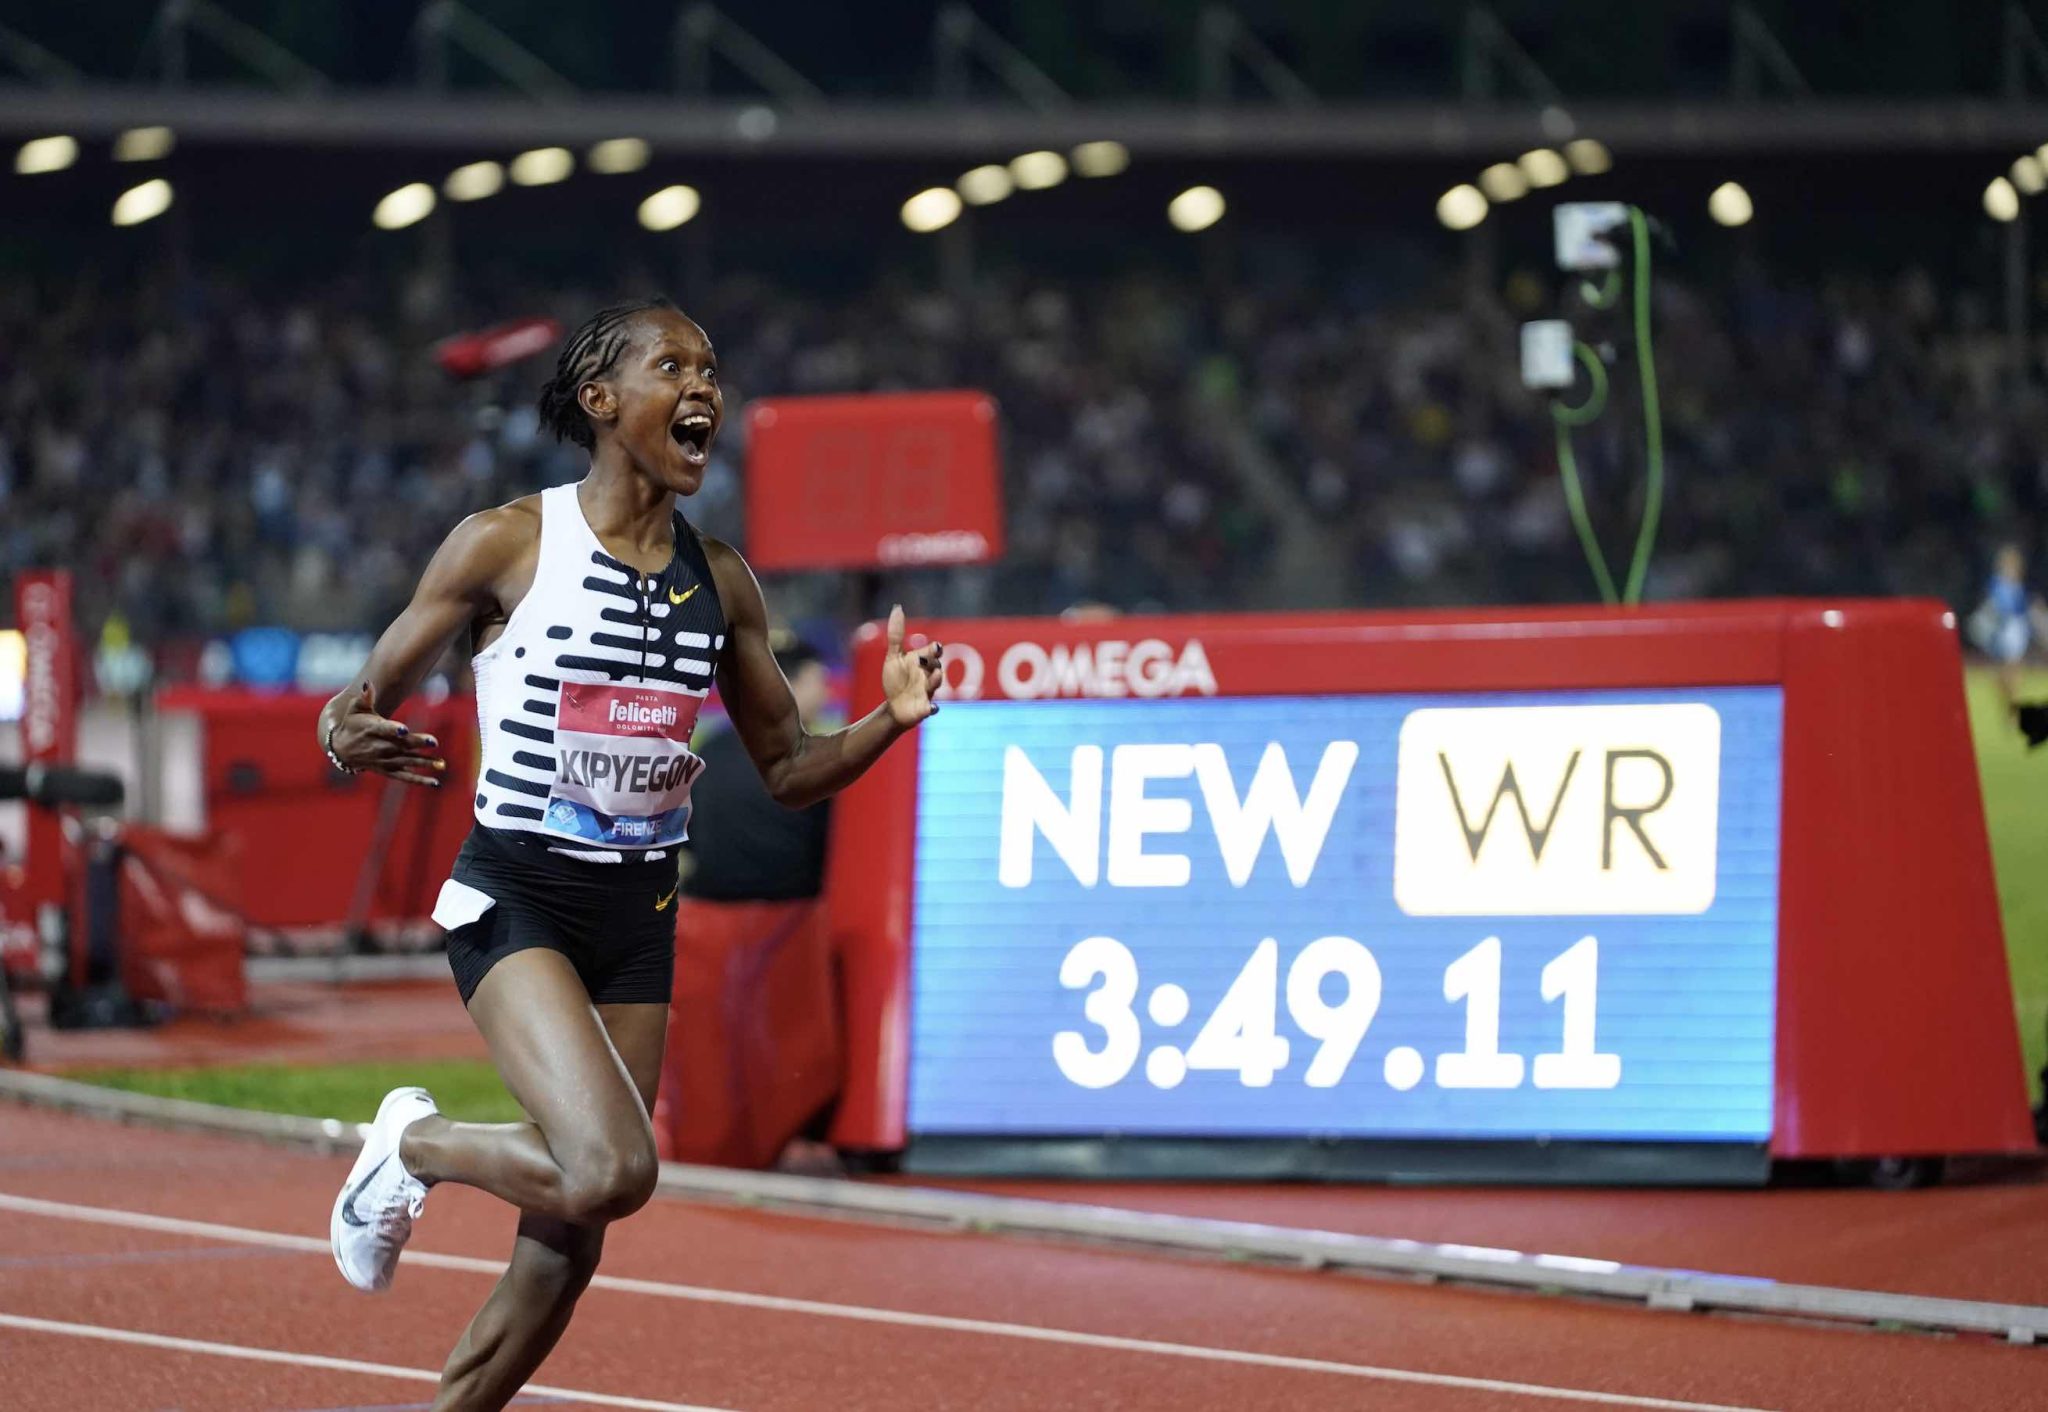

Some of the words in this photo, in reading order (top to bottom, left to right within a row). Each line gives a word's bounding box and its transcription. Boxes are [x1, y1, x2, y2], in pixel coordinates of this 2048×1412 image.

[999, 640, 1219, 697] OMEGA
[609, 699, 677, 727] felicetti
[616, 724, 654, 732] DOLOMITI
[561, 749, 701, 793] KIPYEGON
[611, 819, 661, 837] FIRENZE
[1000, 742, 1359, 888] NEW
[1438, 749, 1674, 870] WR
[1053, 936, 1621, 1091] 3:49.11
